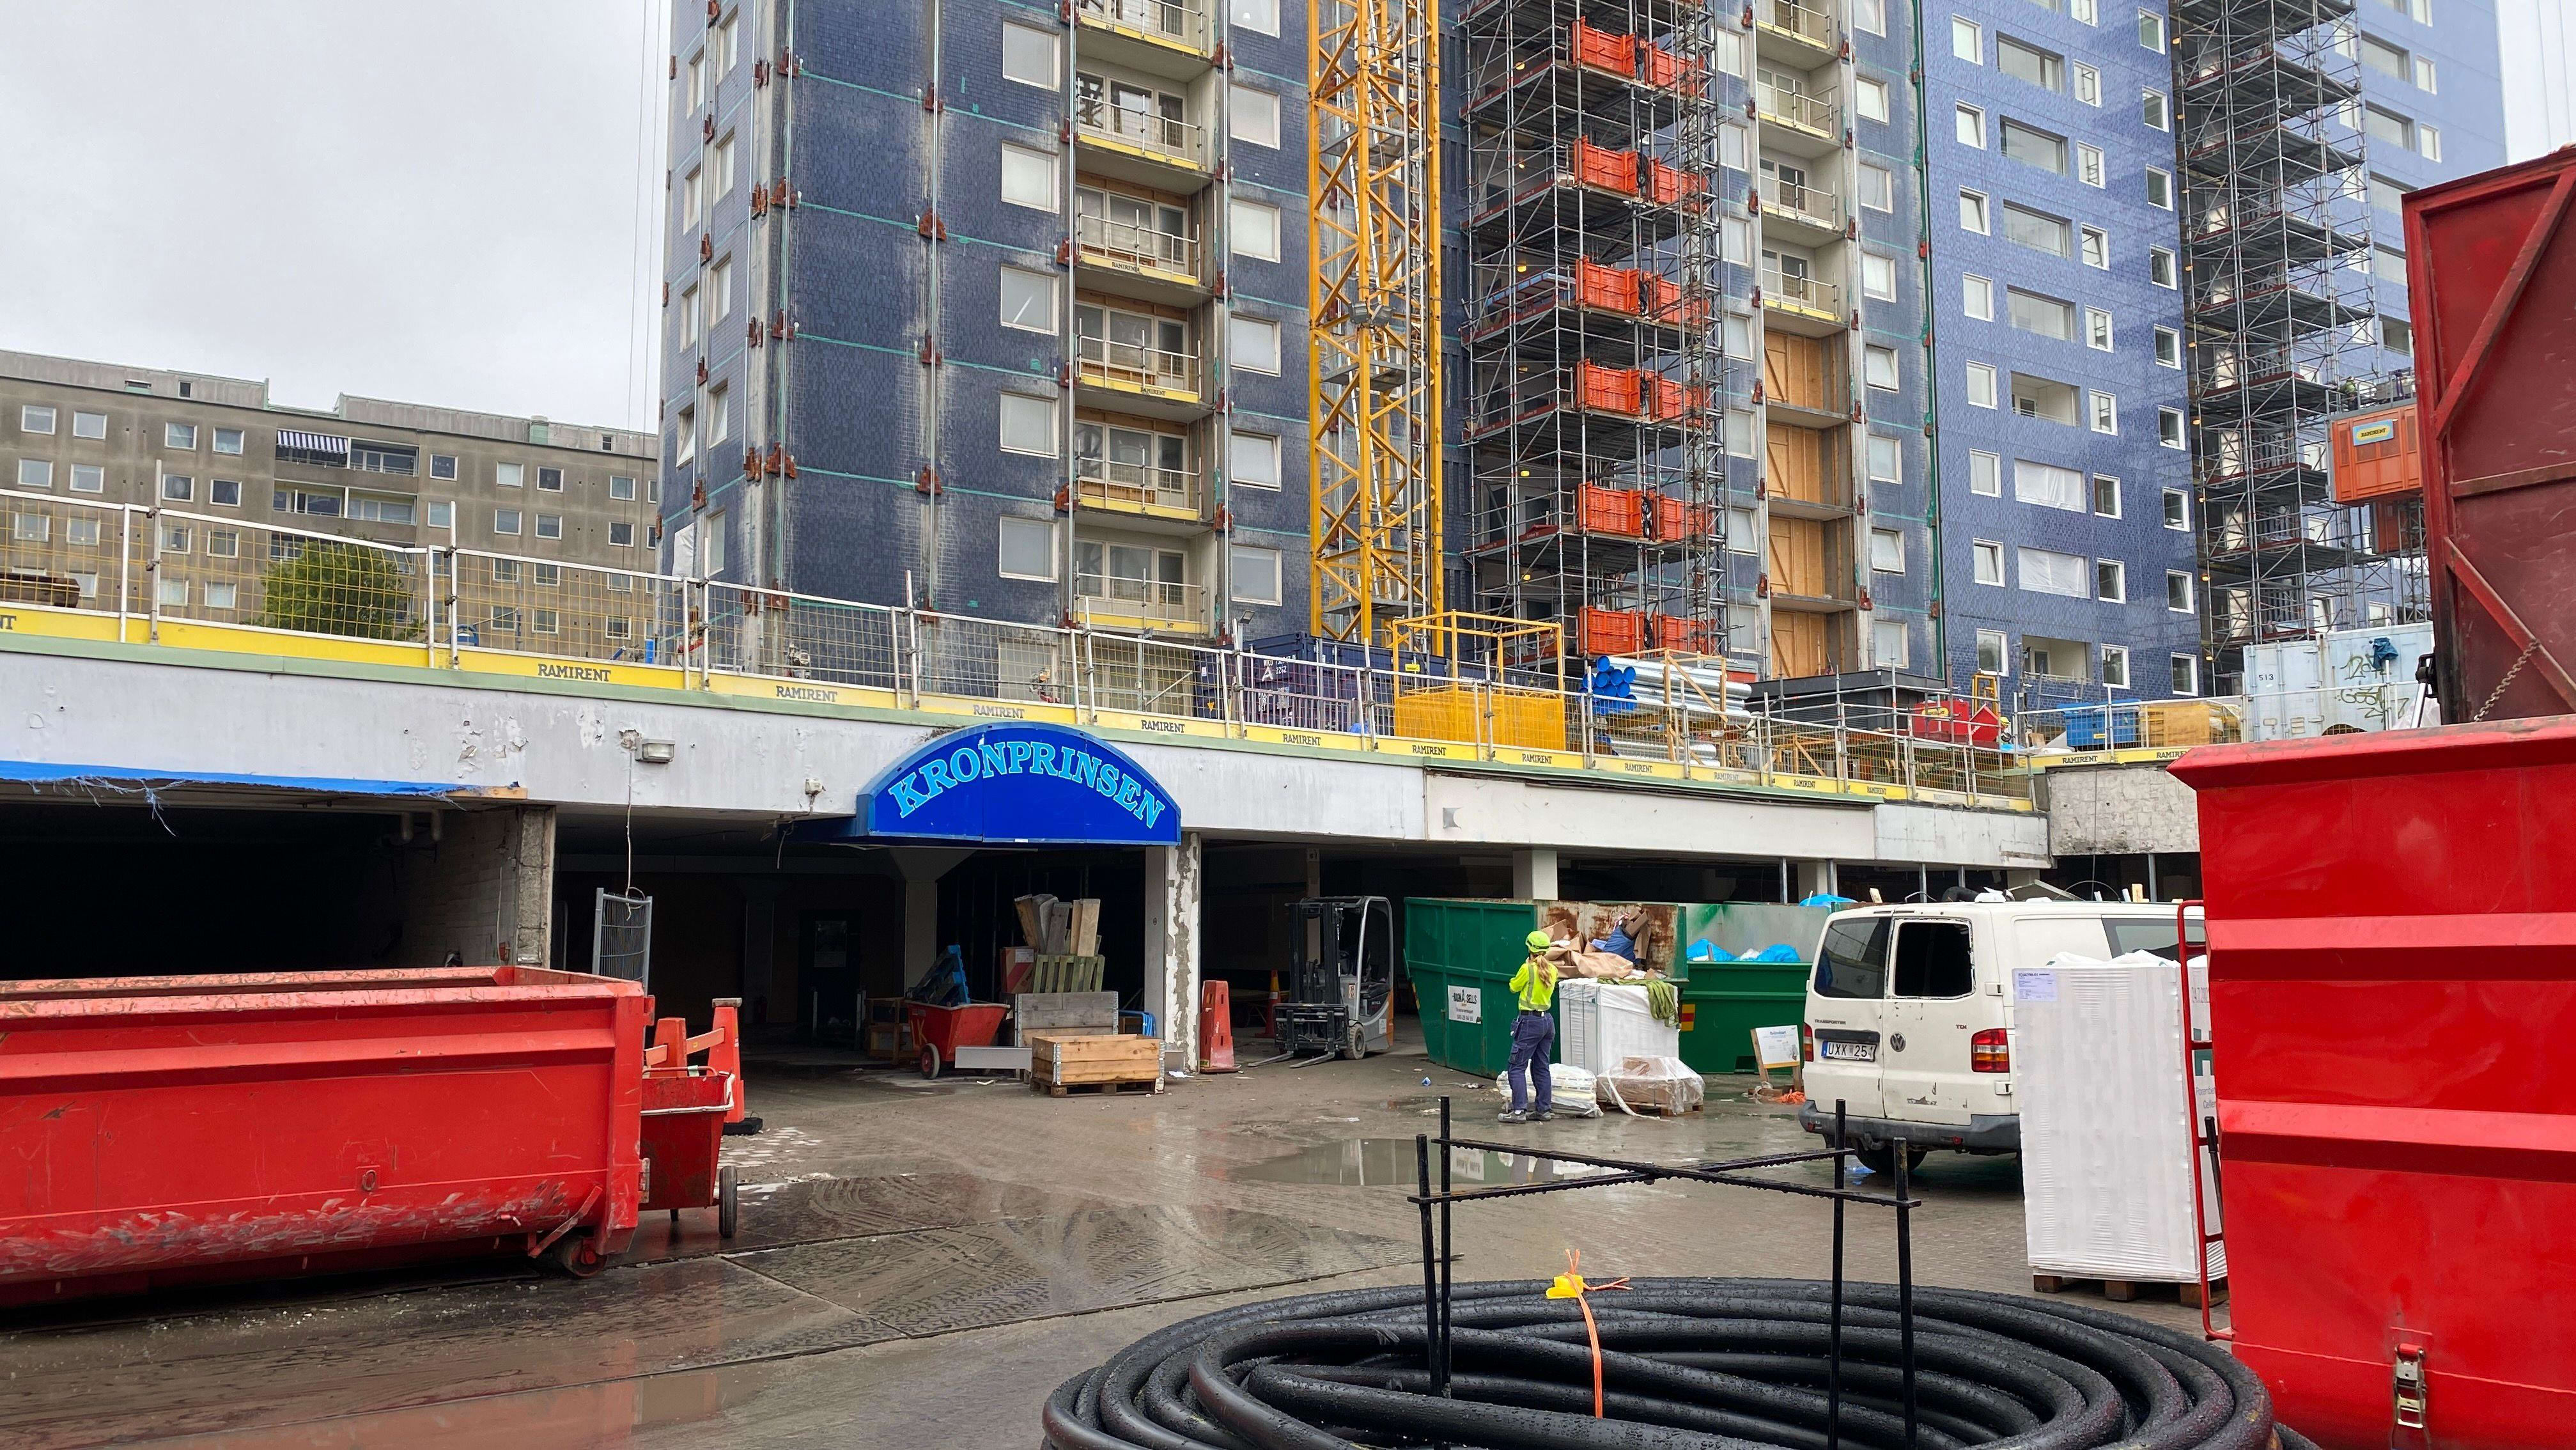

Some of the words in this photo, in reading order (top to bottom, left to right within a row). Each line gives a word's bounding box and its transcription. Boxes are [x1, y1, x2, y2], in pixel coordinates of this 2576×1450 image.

[538, 663, 611, 682] RAMIRENT
[775, 685, 837, 702] RAMIRENT
[973, 704, 1025, 719] RAMIRENT
[1141, 720, 1185, 733] RAMIRENT
[1282, 733, 1321, 746] RAMIRENT
[1412, 745, 1447, 756] RAMIRENT
[1522, 753, 1552, 765] RAMIRENT
[2062, 755, 2099, 764] RAMIRENT
[1624, 763, 1653, 774] RAMIRENT
[1714, 772, 1739, 783] RAMIRENT
[888, 741, 1165, 829] KRONPRINSEN
[1794, 779, 1816, 789] RAMIRENT
